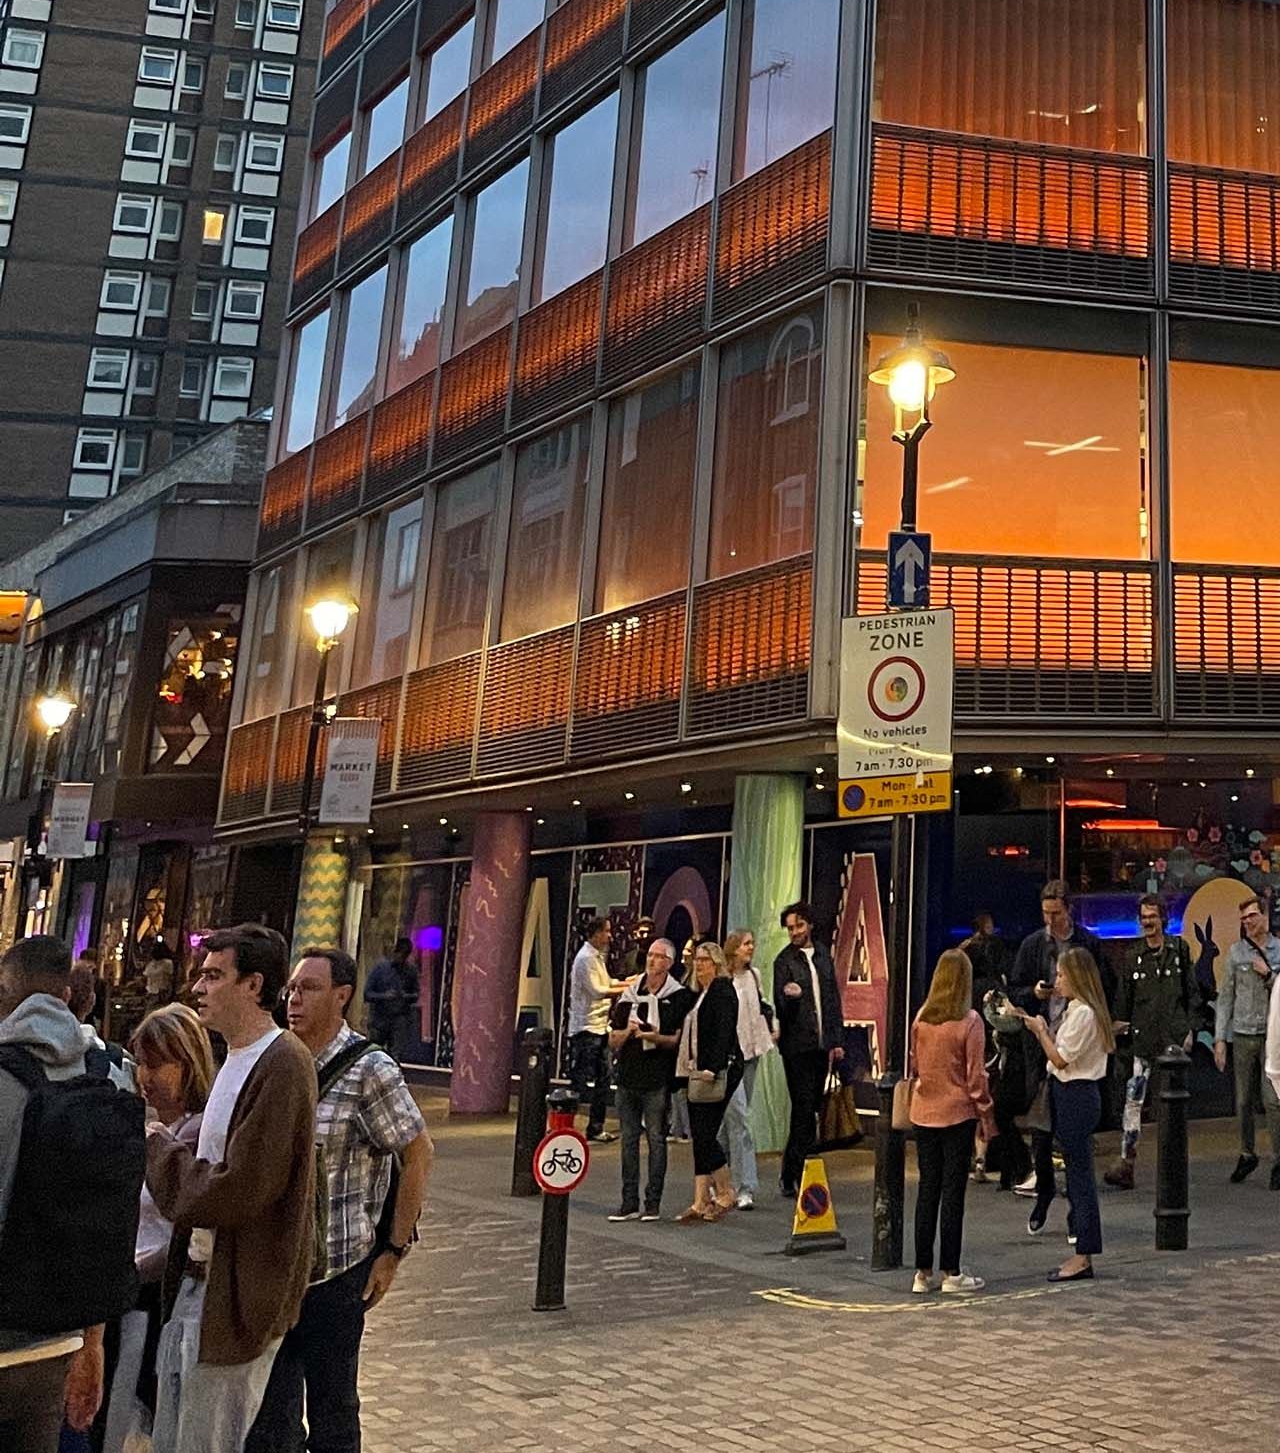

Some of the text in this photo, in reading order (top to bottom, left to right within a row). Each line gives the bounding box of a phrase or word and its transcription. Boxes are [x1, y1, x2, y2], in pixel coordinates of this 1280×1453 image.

[859, 615, 936, 632] PEDESTRIAN
[869, 631, 924, 652] ZONE
[863, 725, 927, 739] No vehicles
[329, 762, 373, 772] MARKET
[881, 780, 906, 792] Mon
